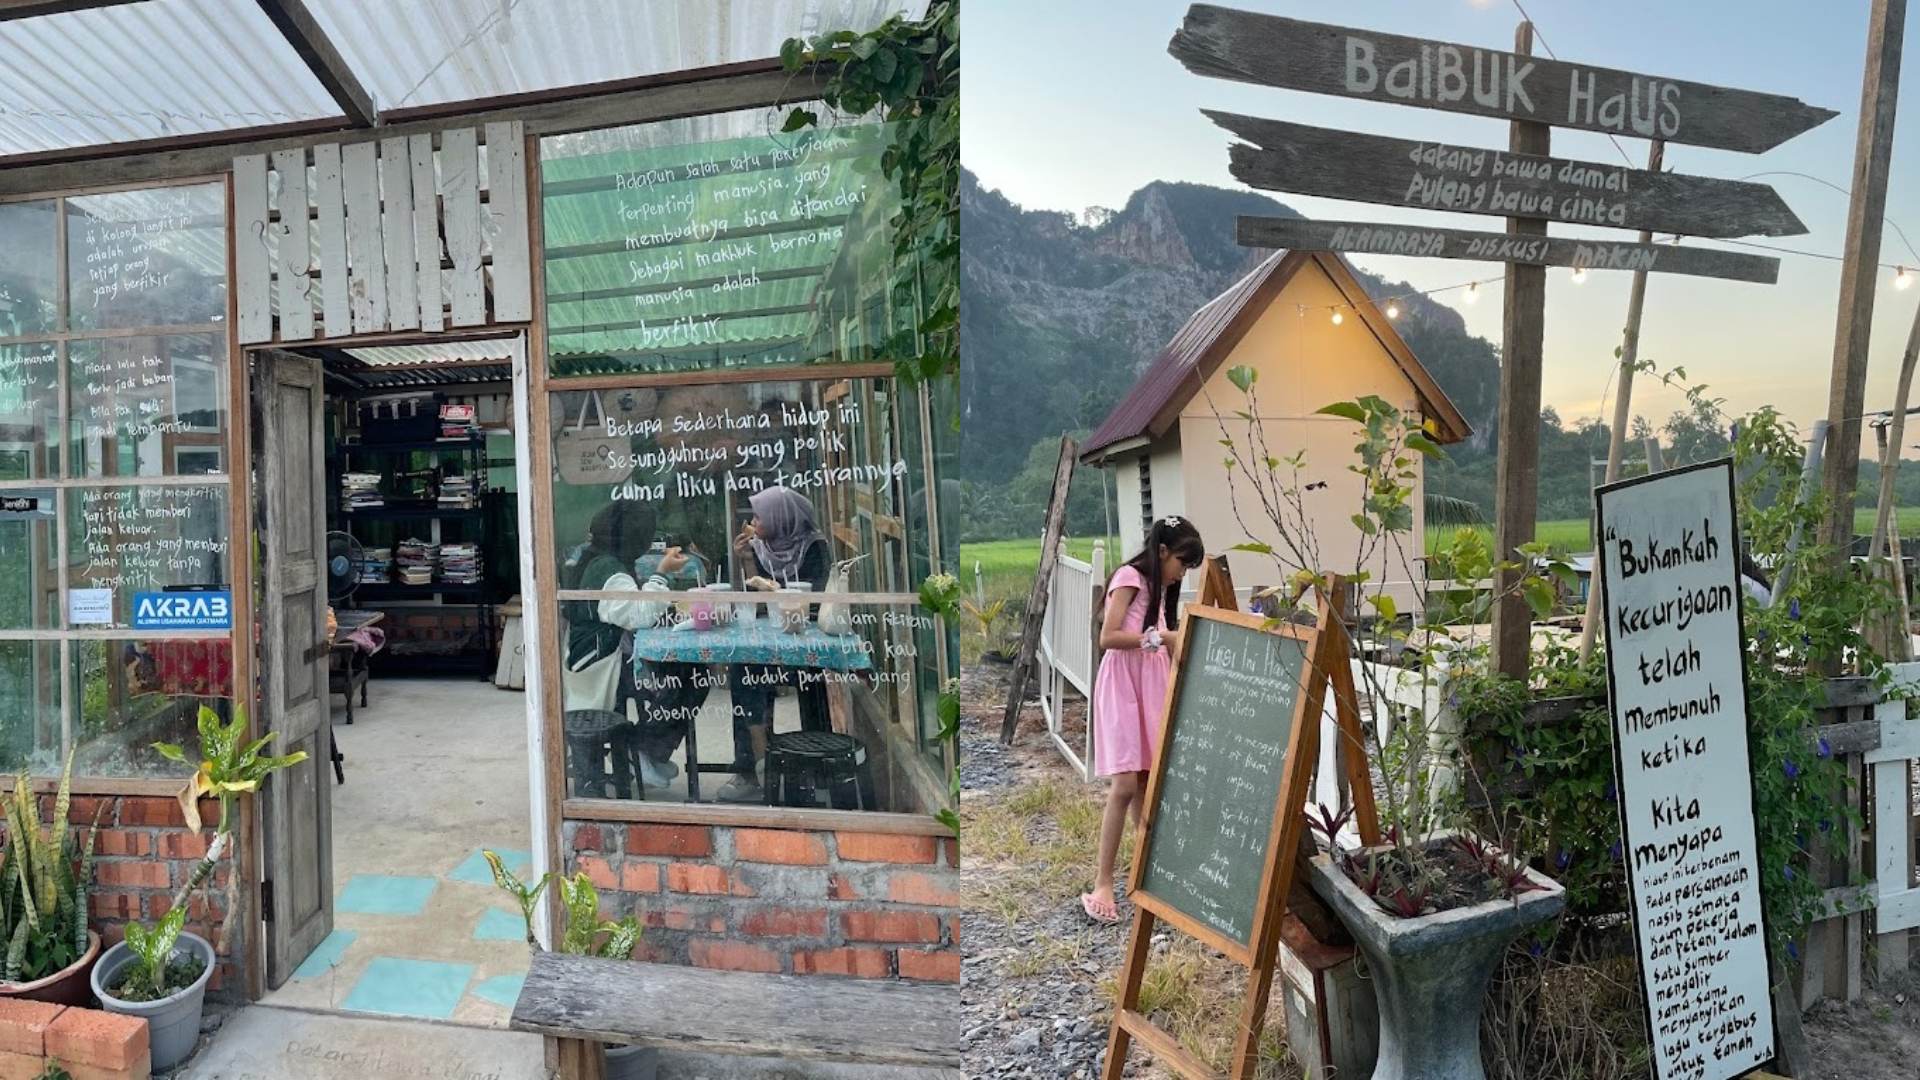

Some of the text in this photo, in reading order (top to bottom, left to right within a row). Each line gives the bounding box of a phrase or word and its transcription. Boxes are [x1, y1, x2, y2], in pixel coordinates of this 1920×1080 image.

[1409, 142, 1485, 178] datang
[1491, 151, 1551, 180] bawa
[794, 164, 831, 196] yang
[624, 184, 867, 250] membuatnya bisa ditandai
[1489, 180, 1553, 215] bawa
[1560, 191, 1626, 225] cinta
[769, 225, 844, 254] bernama
[1329, 229, 1445, 255] ALAMRAYA
[1573, 244, 1658, 271] MAKAN
[93, 283, 118, 308] yang
[635, 267, 760, 308] manusia adalah
[640, 313, 721, 345] berfikir
[606, 415, 662, 440] Betapa
[782, 402, 829, 427] hidup
[839, 402, 861, 425] ini
[736, 438, 786, 470] yang
[793, 431, 846, 461] pelik
[610, 459, 907, 502] cuma liku dan tafsirannya
[115, 540, 151, 556] orang
[156, 538, 182, 557] yang
[167, 556, 201, 574] tanpa
[137, 598, 228, 617] AKRAB
[840, 632, 875, 655] bila
[884, 638, 918, 658] kau
[1638, 639, 1701, 686] telah
[633, 667, 683, 691] belum
[741, 667, 789, 686] duduk
[798, 668, 861, 691] perkara
[868, 669, 912, 694] yang
[1684, 849, 1740, 875] terbenam
[1648, 890, 1740, 930] nasib semata
[1686, 908, 1738, 938] pekerja
[1650, 943, 1672, 961] dan
[1724, 921, 1757, 941] dalam
[1684, 949, 1730, 976] sumber
[1656, 970, 1712, 1002] mengalir
[1659, 994, 1745, 1039] menyanyikan
[1663, 1038, 1691, 1064] lagu
[1667, 1053, 1705, 1079] untuk
[1713, 1031, 1753, 1061] tanah
